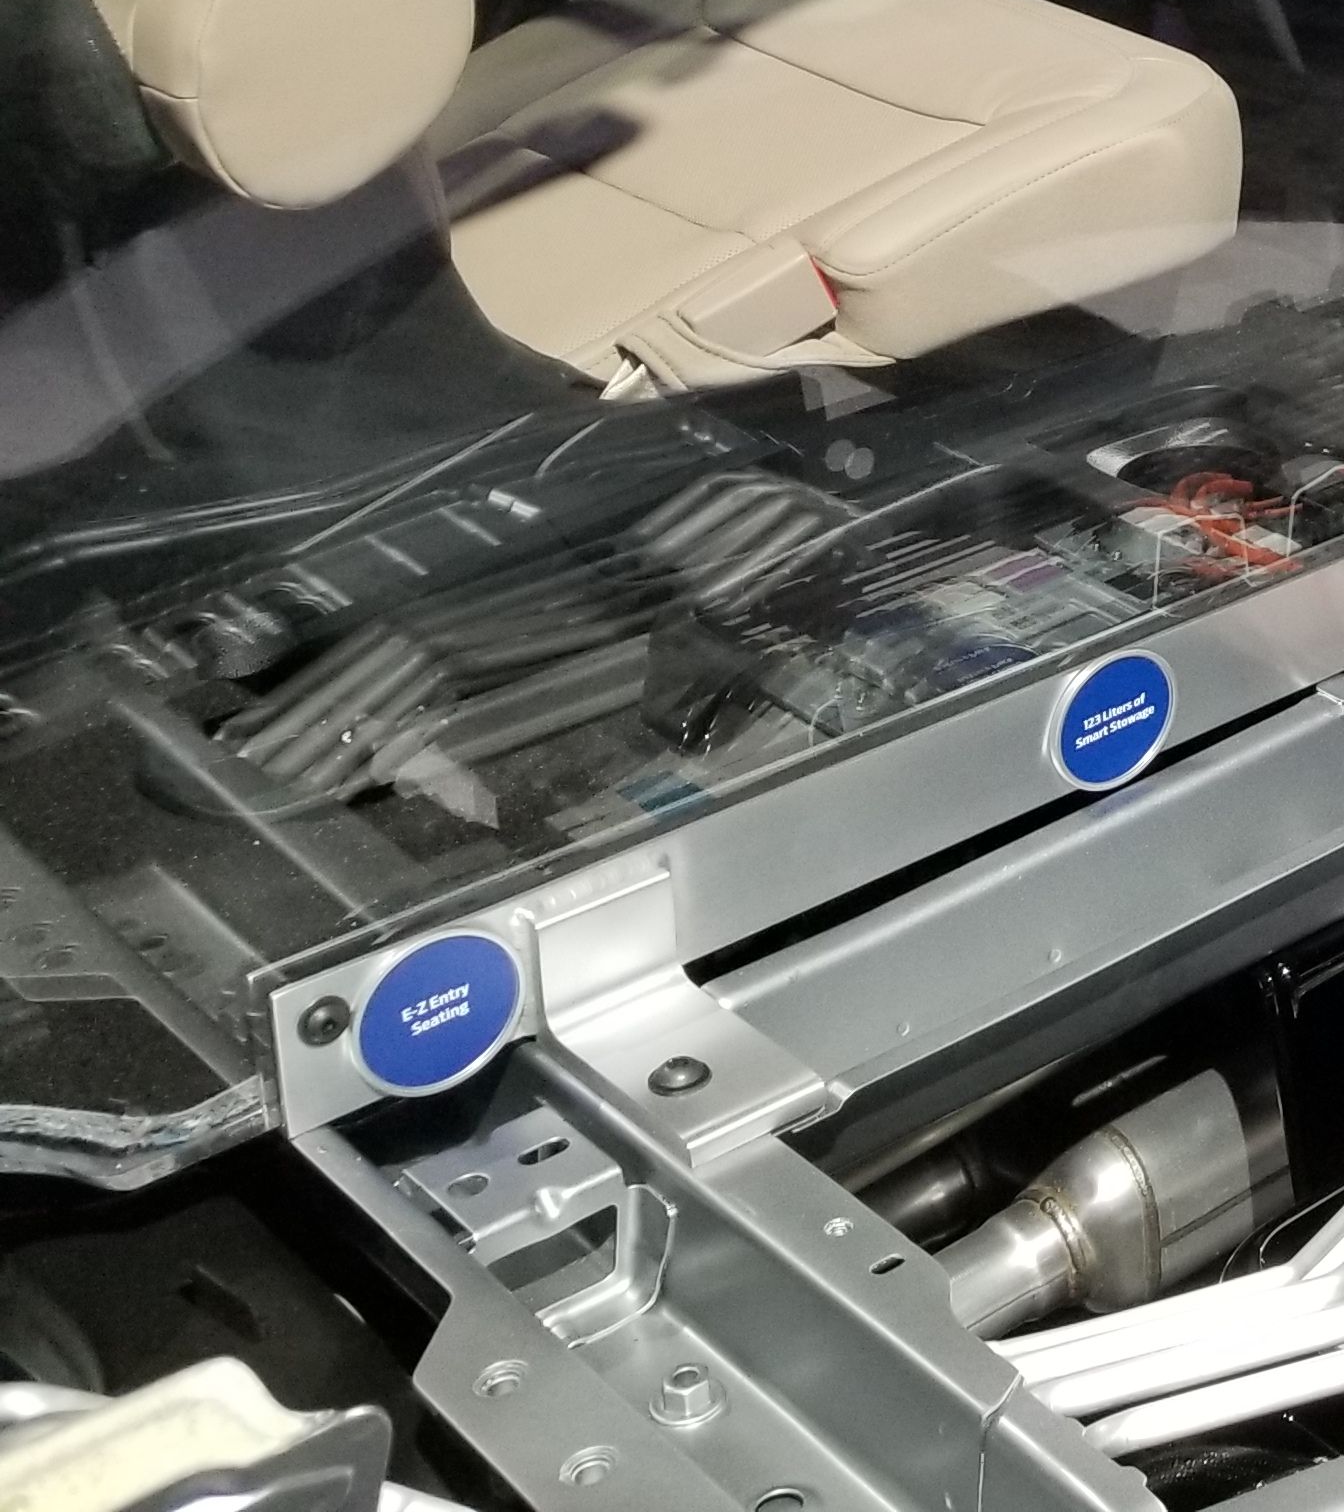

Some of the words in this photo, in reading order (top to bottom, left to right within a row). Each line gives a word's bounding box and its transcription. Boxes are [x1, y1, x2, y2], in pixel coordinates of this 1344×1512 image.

[1075, 725, 1109, 750] Smart
[1108, 705, 1156, 734] Stowage
[1083, 713, 1101, 731] 123
[1102, 700, 1133, 722] Liters
[1133, 691, 1146, 707] of
[401, 999, 429, 1023] E-Z
[428, 982, 470, 1011] Entry
[410, 1000, 471, 1037] Seating
